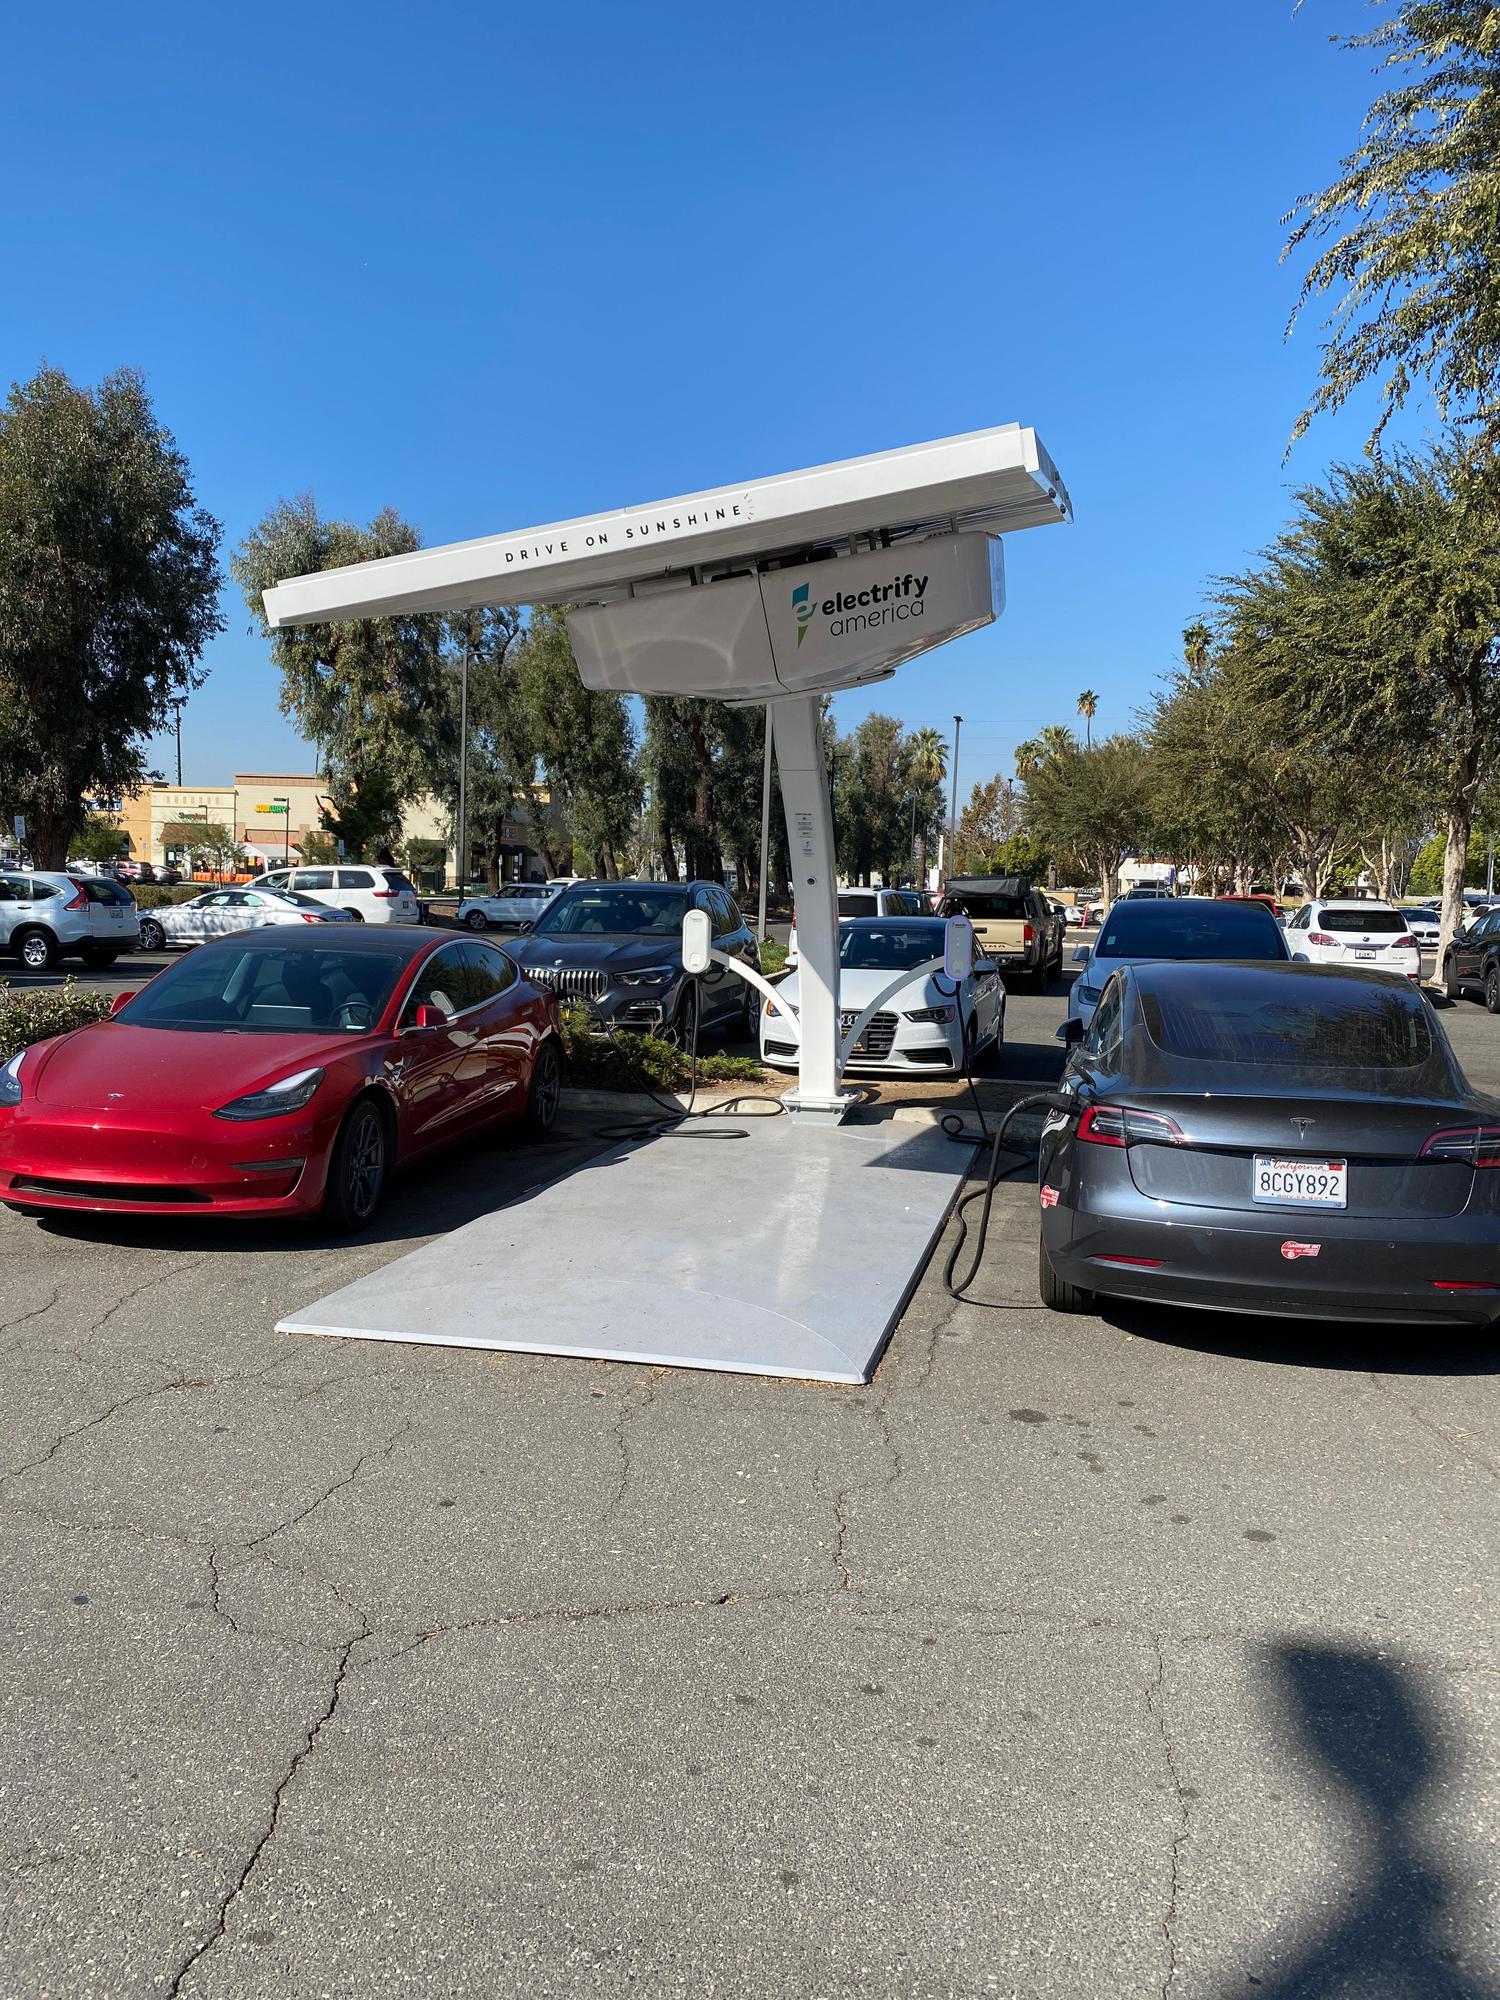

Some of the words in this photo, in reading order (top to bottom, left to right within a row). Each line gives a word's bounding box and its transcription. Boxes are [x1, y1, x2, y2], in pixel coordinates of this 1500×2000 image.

[505, 541, 568, 563] DRIVE
[586, 533, 608, 547] ON
[626, 505, 741, 539] SUNSHINE
[822, 574, 929, 616] electrify
[830, 600, 924, 636] america
[1260, 1172, 1340, 1196] 8CGY892
[1273, 1160, 1325, 1173] California
